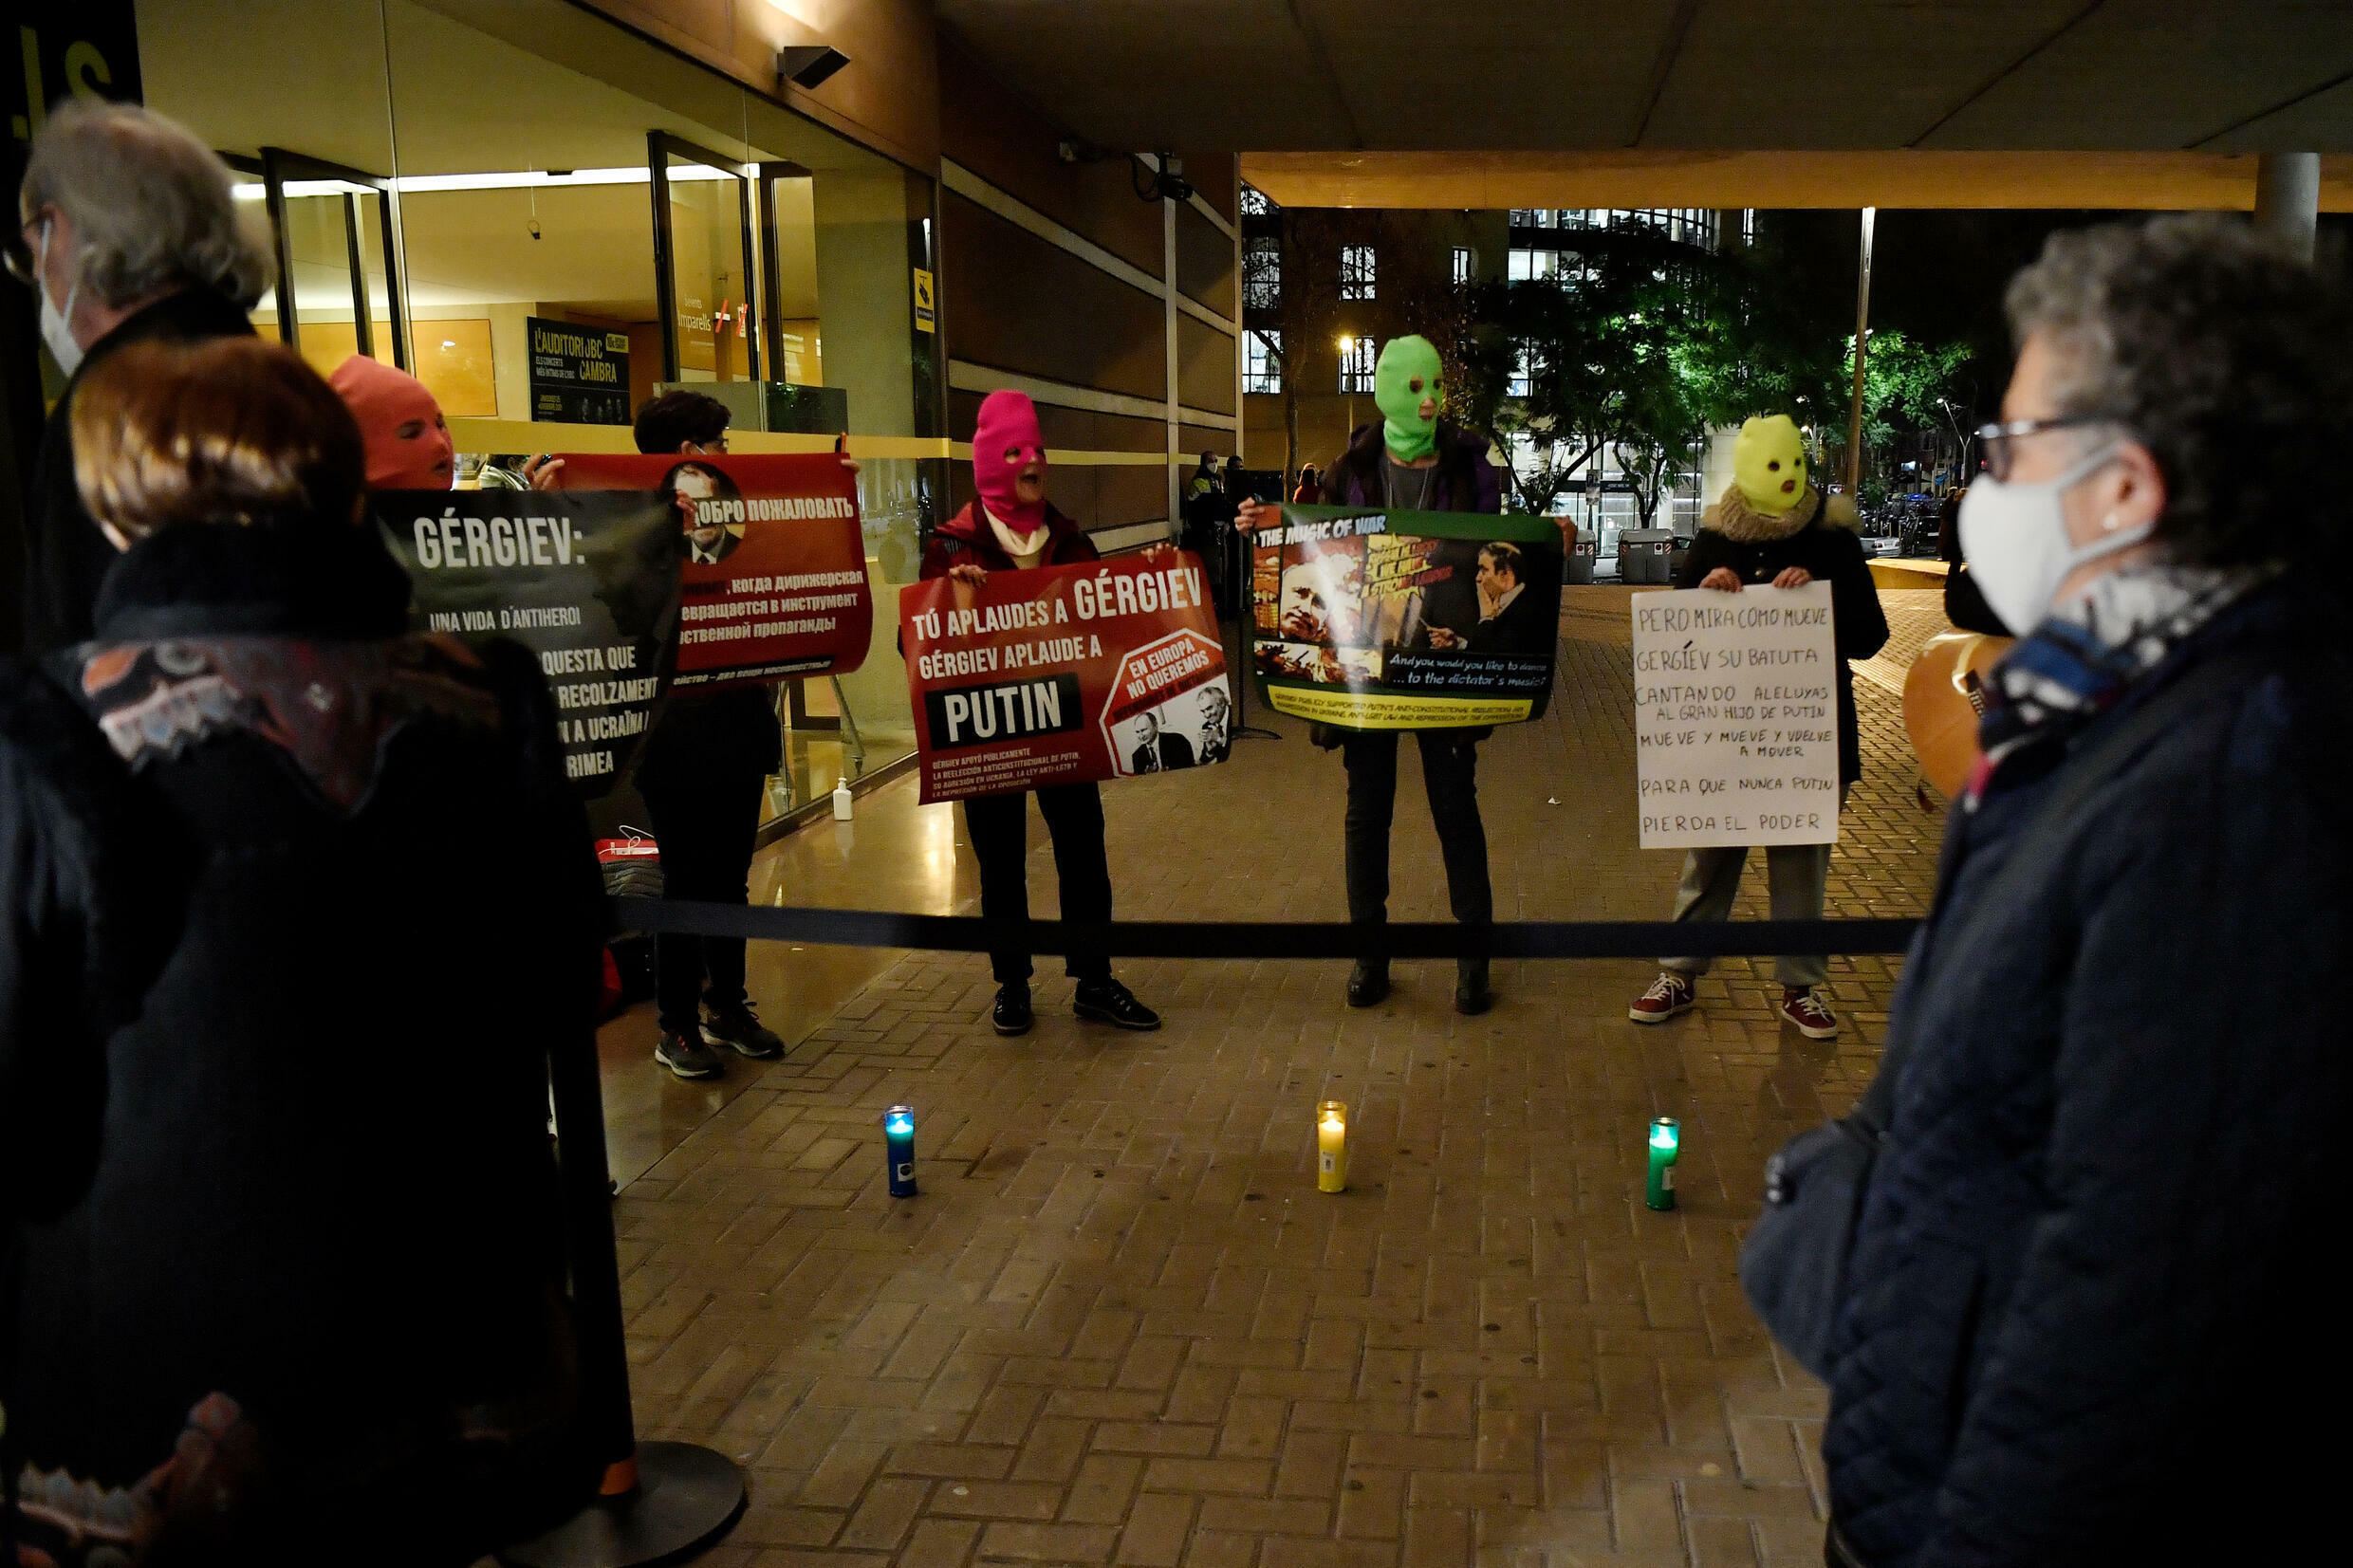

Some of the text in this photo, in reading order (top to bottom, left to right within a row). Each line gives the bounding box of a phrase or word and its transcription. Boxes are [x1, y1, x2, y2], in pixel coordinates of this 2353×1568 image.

[534, 327, 584, 358] L'AUDITORI
[580, 360, 617, 383] CAMBRA
[747, 497, 854, 522] ПОЖАЛОВАТЬ
[413, 507, 586, 568] GÉRGIEV:
[1259, 515, 1386, 548] THE MUSIC OF WAR
[732, 577, 772, 594] когда
[775, 570, 864, 592] дирижерская
[681, 593, 859, 621] евращается в инструмент
[912, 567, 1202, 641] TÚ APLAUDES A GÉRGIEV
[430, 605, 582, 633] UNA VIDA D'ANTIHEROI
[753, 618, 836, 638] пропаганды
[1639, 607, 1827, 632] PERO MIRA COMO MUEVE
[539, 645, 638, 676] QUESTA QUE
[918, 635, 1102, 680] GÉRGIEV APLAUDE A
[1128, 637, 1195, 679] EN EUROPA
[1389, 654, 1414, 665] And
[1414, 658, 1435, 668] you
[1436, 659, 1464, 668] would
[1464, 662, 1483, 672] you
[1485, 660, 1504, 671] like
[1508, 661, 1518, 671] to
[1636, 640, 1818, 673] GERGÍEV SU BATUTA
[1126, 678, 1147, 699] NO
[1146, 650, 1210, 691] QUEREMOS
[1407, 672, 1421, 684] to
[1424, 672, 1444, 685] the
[1448, 673, 1505, 686] dictator's
[557, 676, 659, 709] RECOLZAMENT
[1634, 686, 1829, 706] CANTANDO ALELUYAS
[944, 680, 1063, 743] PUTIN
[1656, 706, 1825, 721] AL GRAN HIJO DE PUTIN
[574, 719, 586, 743] A
[1640, 729, 1832, 747] MUEVE Y MUEVE Y VUELVE
[566, 750, 615, 778] RIMEA
[1740, 747, 1805, 758] A MOVER
[1641, 777, 1833, 797] PARA QUE NUNCA PUTIN
[1642, 814, 1820, 833] PIERDA EL PODER
